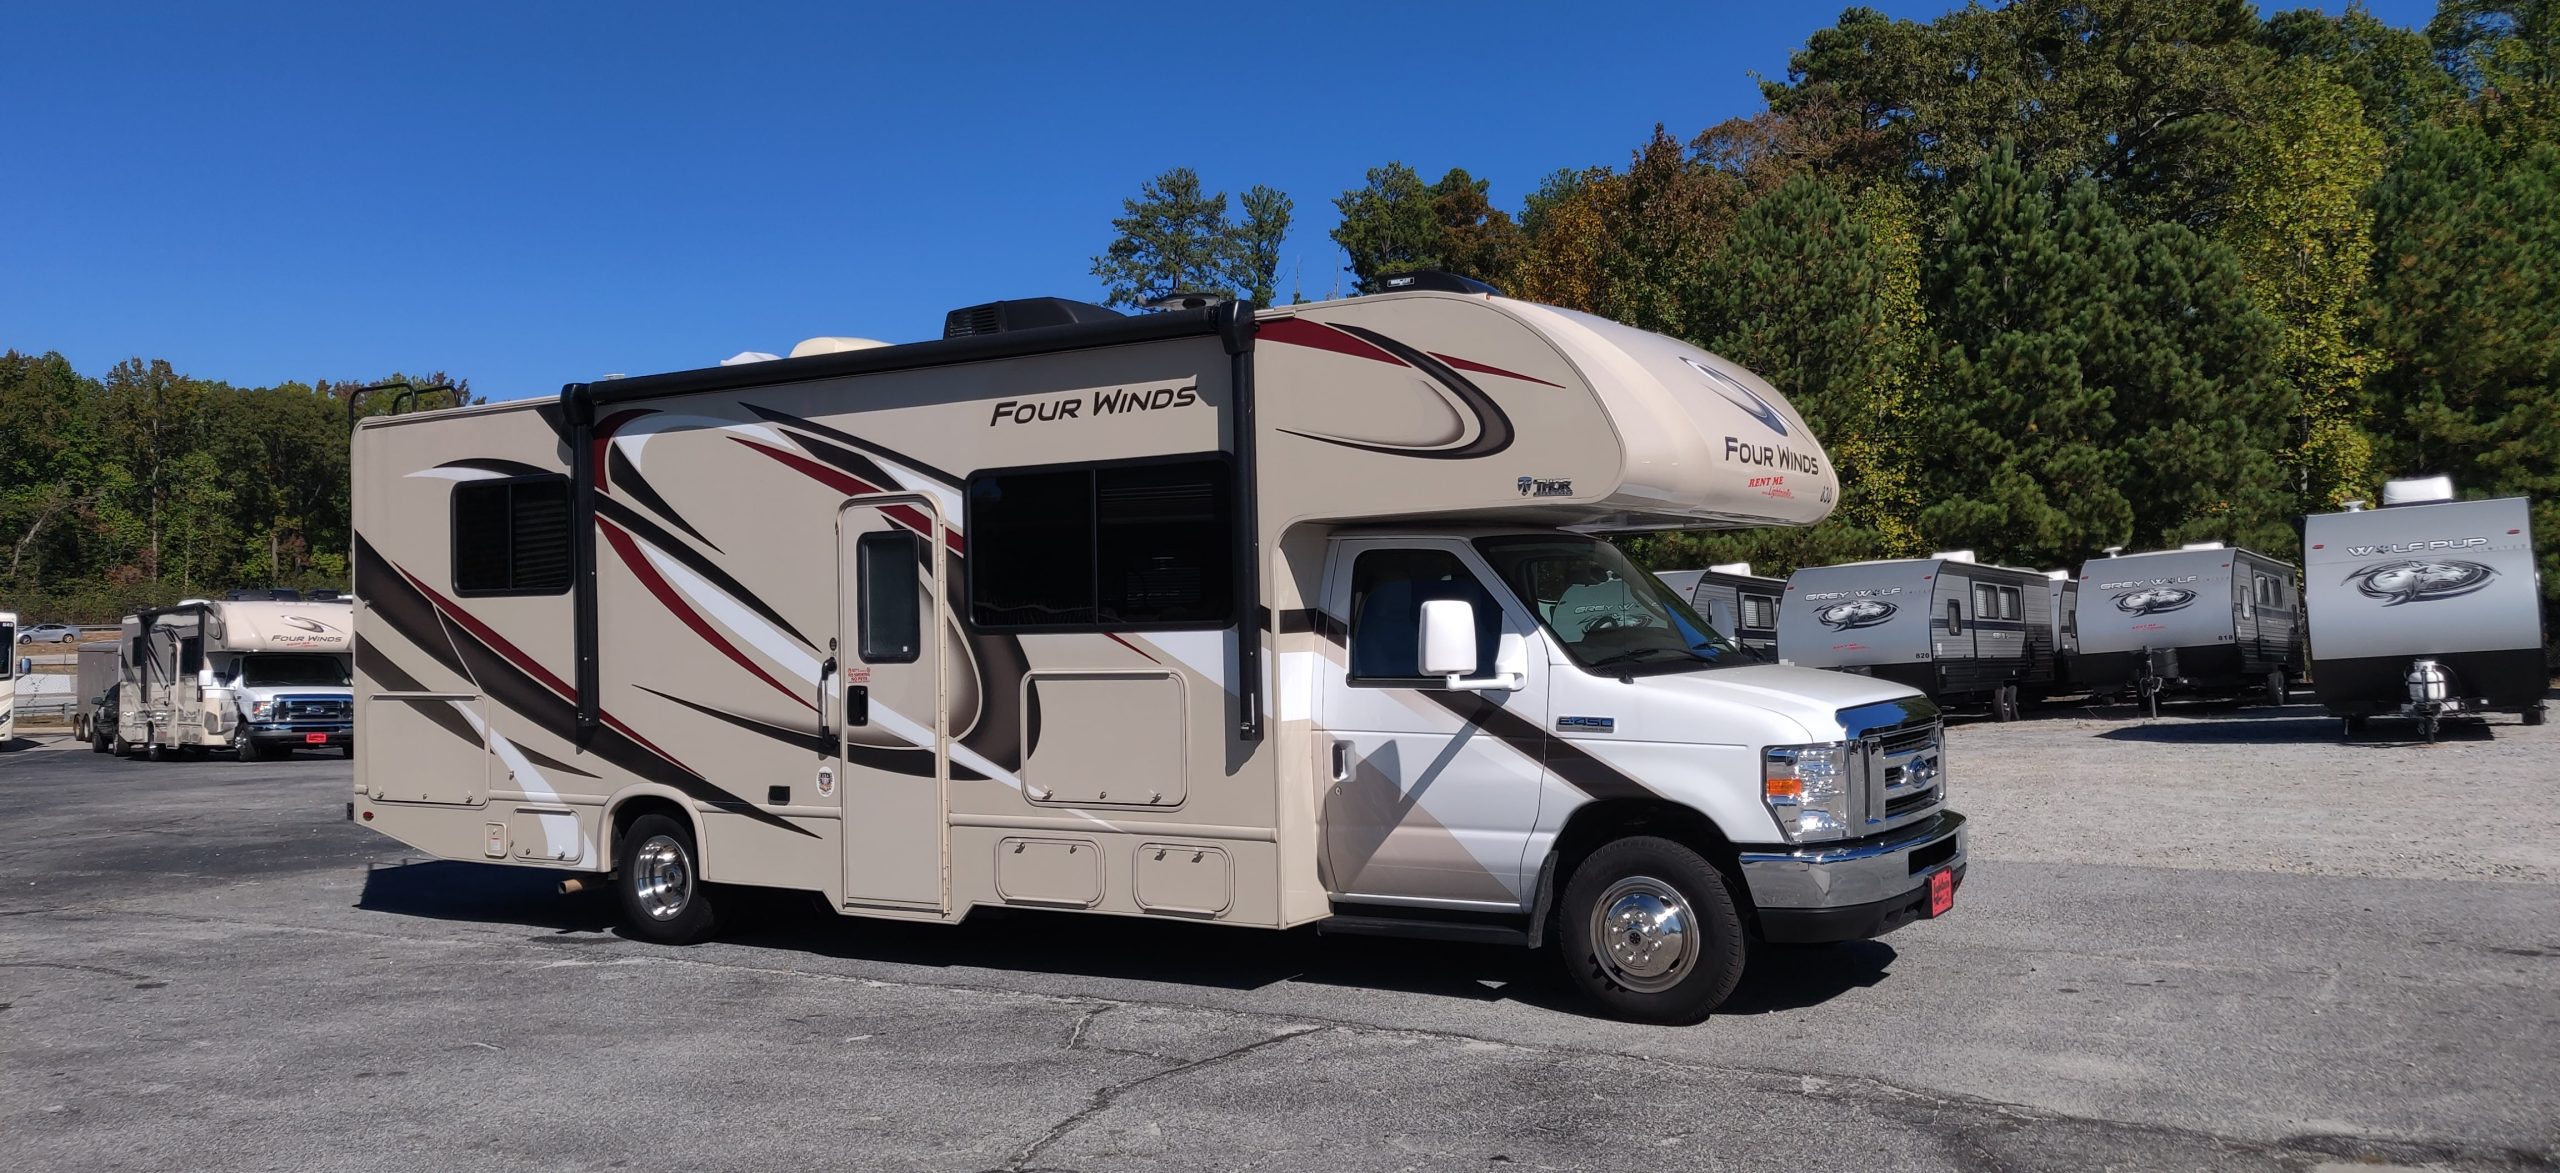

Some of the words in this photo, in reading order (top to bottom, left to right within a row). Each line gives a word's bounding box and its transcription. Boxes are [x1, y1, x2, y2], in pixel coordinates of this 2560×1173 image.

[990, 399, 1082, 427] FOUR
[1093, 385, 1198, 416] WINDS
[1724, 436, 1774, 468] FOUR
[1776, 444, 1819, 475] WINDS
[1532, 478, 1574, 493] THOR
[1748, 477, 1771, 488] RENT
[1772, 476, 1784, 486] ME
[2429, 537, 2488, 550] PUP
[2100, 580, 2144, 591] GREY
[1805, 591, 1849, 601] GREY
[271, 634, 306, 642] FOUR
[307, 634, 343, 643] WINDS
[1915, 652, 1931, 660] 820
